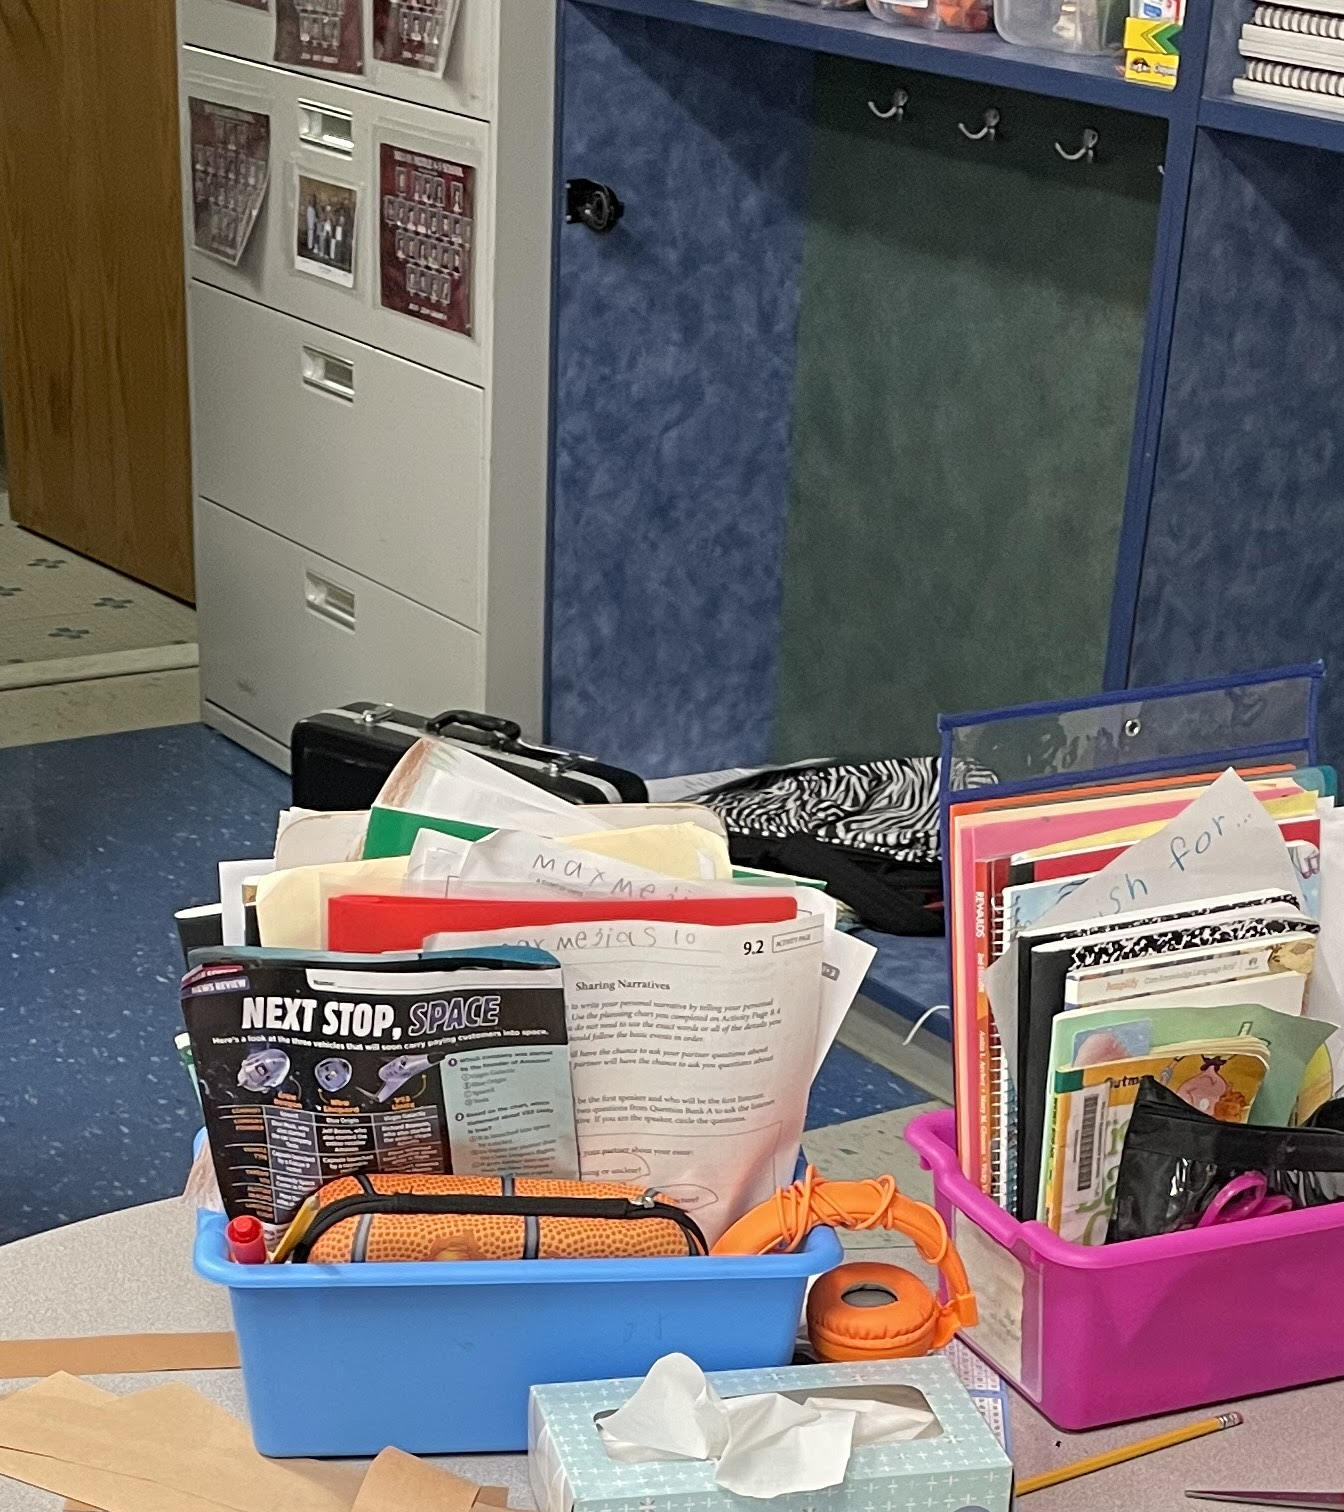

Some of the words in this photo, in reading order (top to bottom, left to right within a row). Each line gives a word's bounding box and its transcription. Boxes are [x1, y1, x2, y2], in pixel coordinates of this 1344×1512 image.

[975, 890, 986, 939] REWARDS
[743, 939, 765, 956] 9.2
[575, 980, 616, 992] Sharing
[617, 979, 671, 991] Narratives
[241, 996, 318, 1034] NEXT
[321, 1000, 403, 1041] STOP,
[407, 995, 501, 1037] SPACE
[247, 1034, 267, 1043] look
[277, 1035, 291, 1044] the
[291, 1037, 312, 1047] three
[313, 1041, 346, 1050] vehicles
[346, 1043, 364, 1051] that
[365, 1043, 380, 1051] will
[404, 1041, 426, 1051] carry
[427, 1036, 457, 1048] paying
[457, 1031, 502, 1042] customers
[503, 1029, 521, 1037] into
